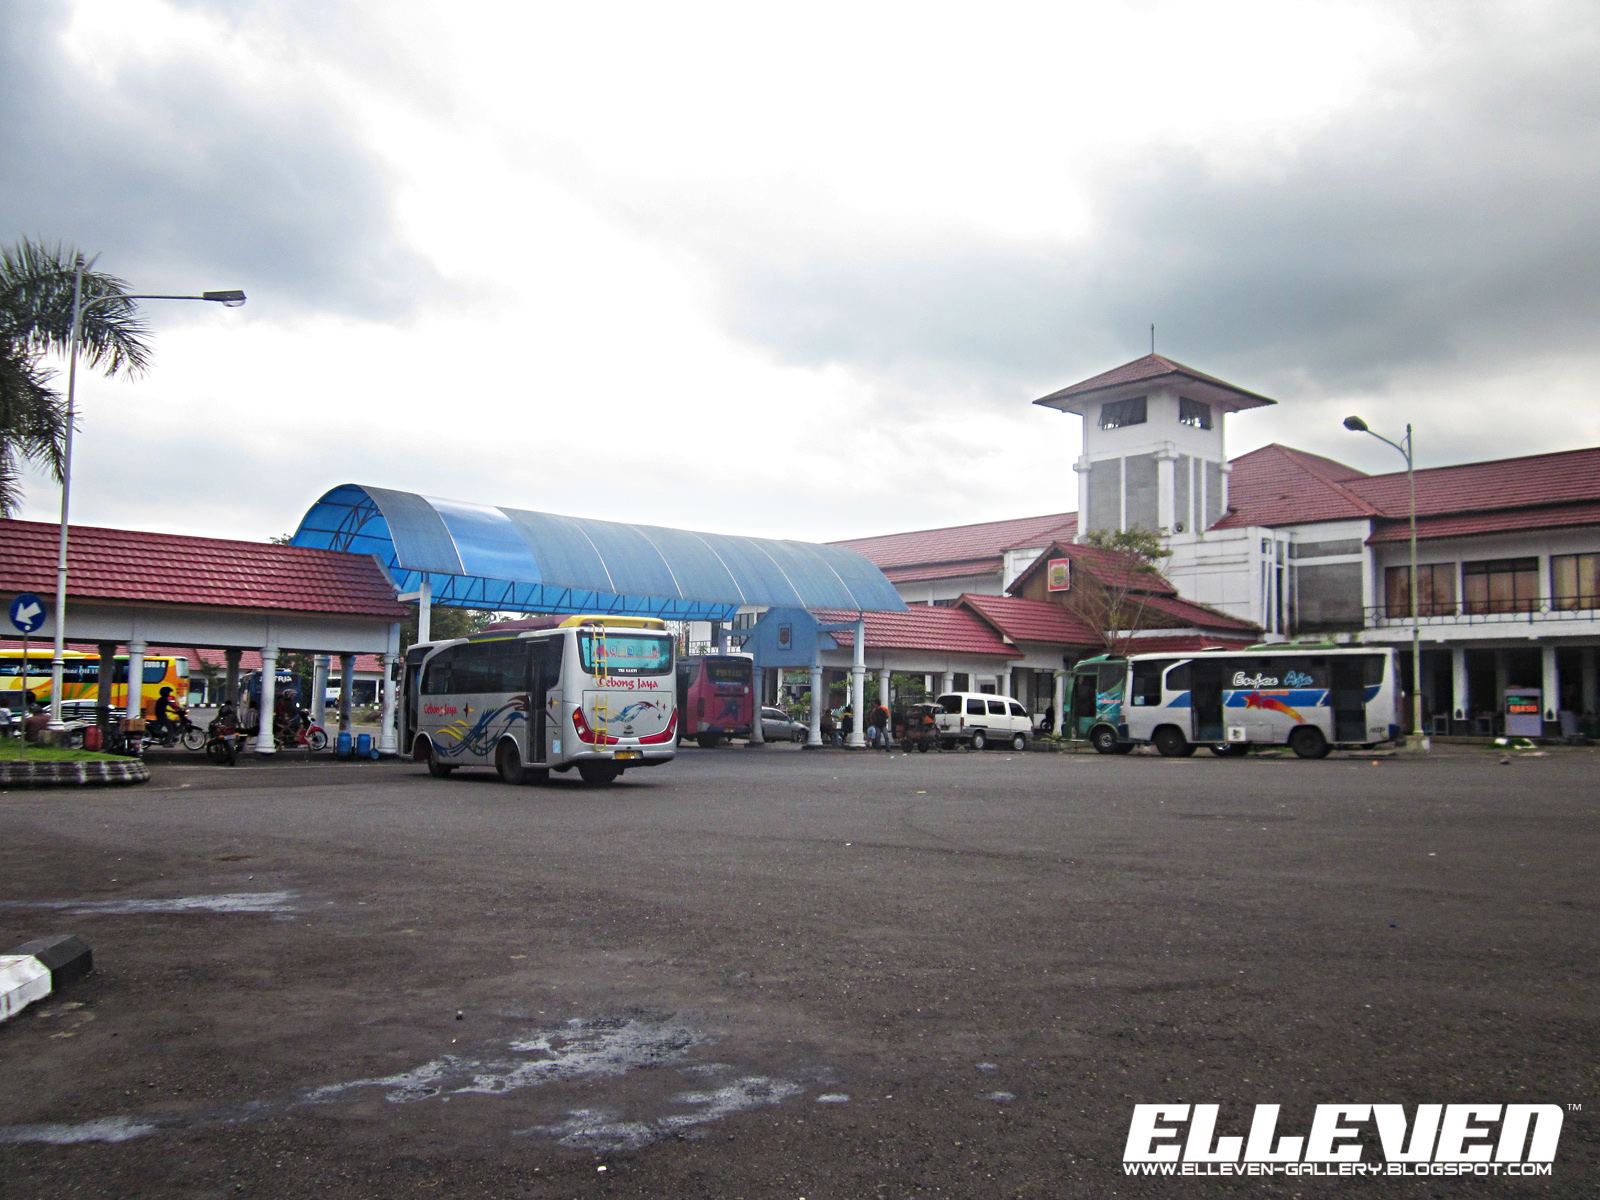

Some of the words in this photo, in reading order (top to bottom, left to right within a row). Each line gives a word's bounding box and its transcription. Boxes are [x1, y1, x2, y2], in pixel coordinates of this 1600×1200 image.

[599, 676, 635, 690] Cebong
[637, 678, 659, 690] Jaya
[444, 703, 458, 717] Jaya
